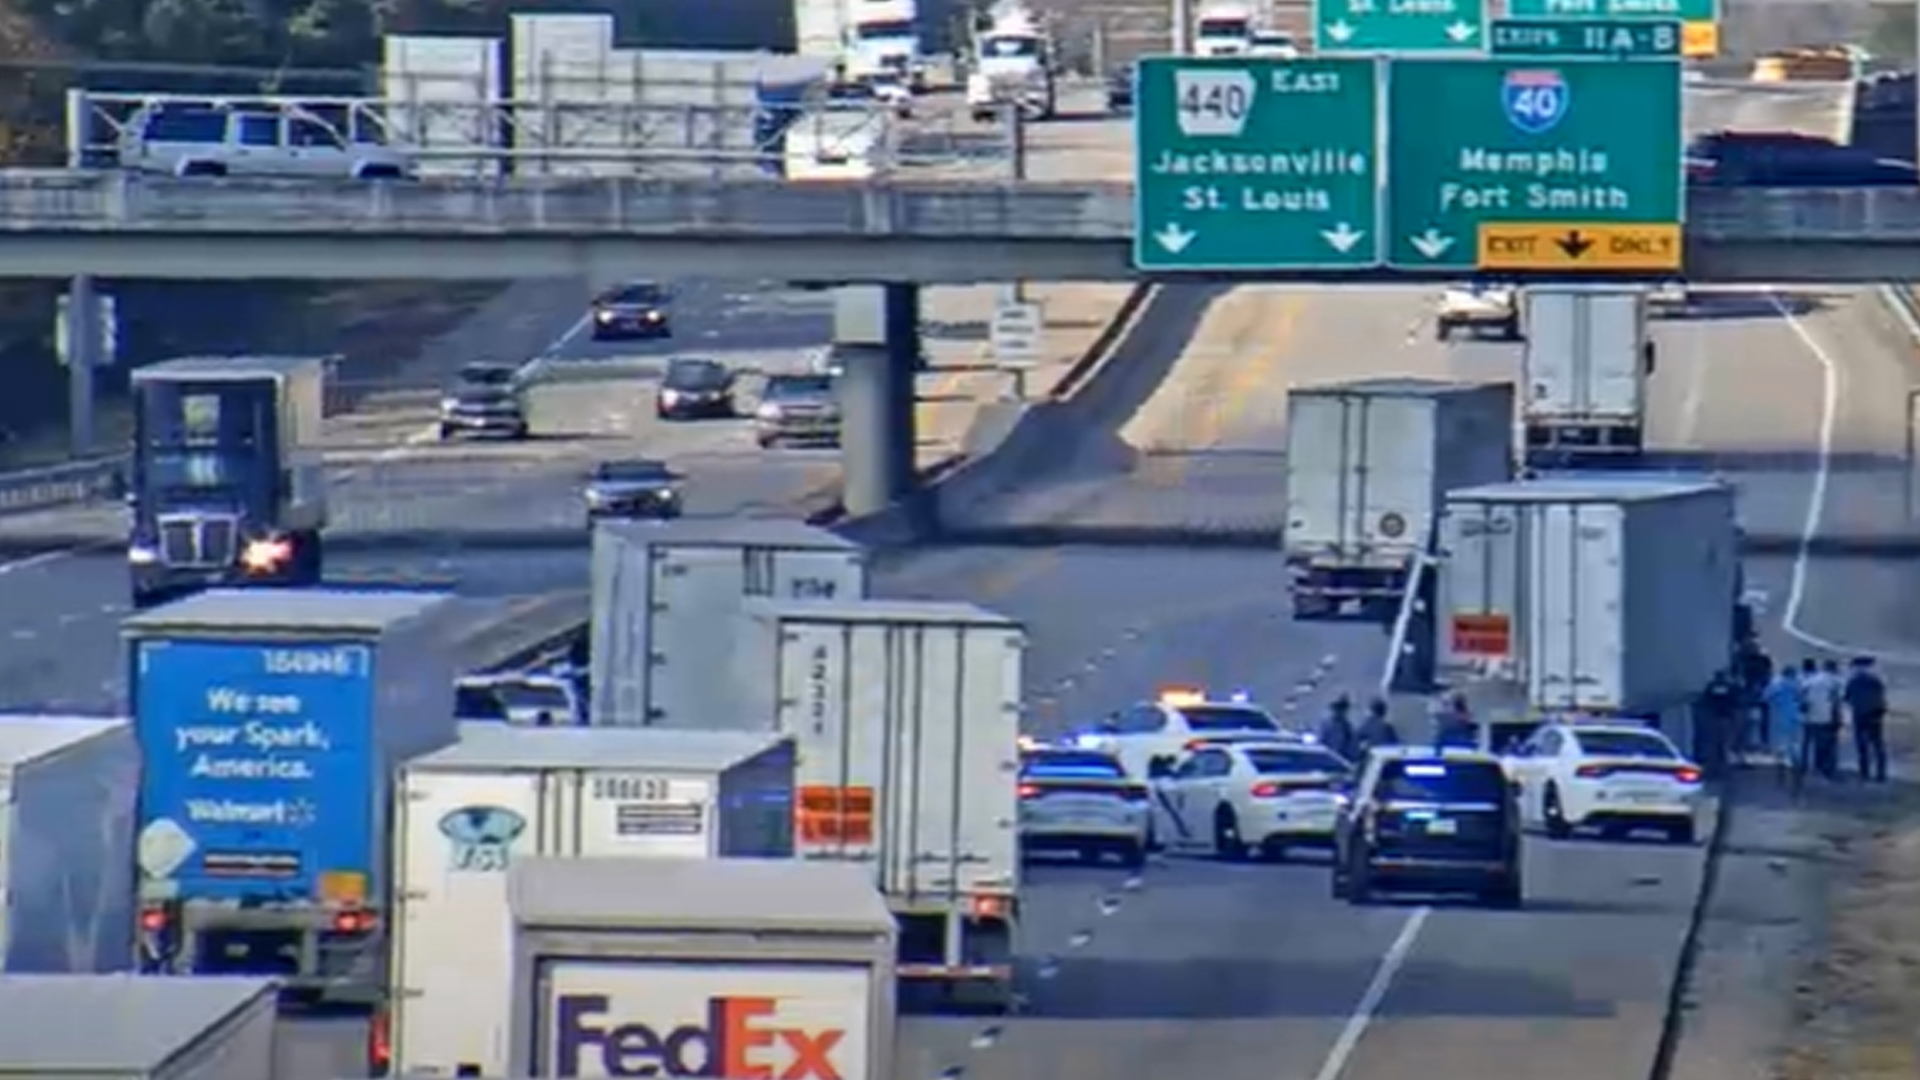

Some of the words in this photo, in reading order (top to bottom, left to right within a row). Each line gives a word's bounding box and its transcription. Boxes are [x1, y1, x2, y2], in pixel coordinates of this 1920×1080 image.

[1272, 69, 1341, 92] EAST
[1181, 84, 1246, 119] 440
[1512, 88, 1558, 118] 40
[1151, 149, 1366, 174] Jacksonville
[1460, 148, 1608, 176] Memphis
[1243, 186, 1331, 211] Louis
[1440, 182, 1510, 212] Fort
[1526, 182, 1629, 210] Smith
[1487, 236, 1538, 255] EXIT
[1608, 234, 1672, 254] ONLY
[207, 687, 250, 714] We
[175, 727, 239, 752] your
[186, 799, 285, 823] Walmart
[557, 995, 845, 1080] FedEx
